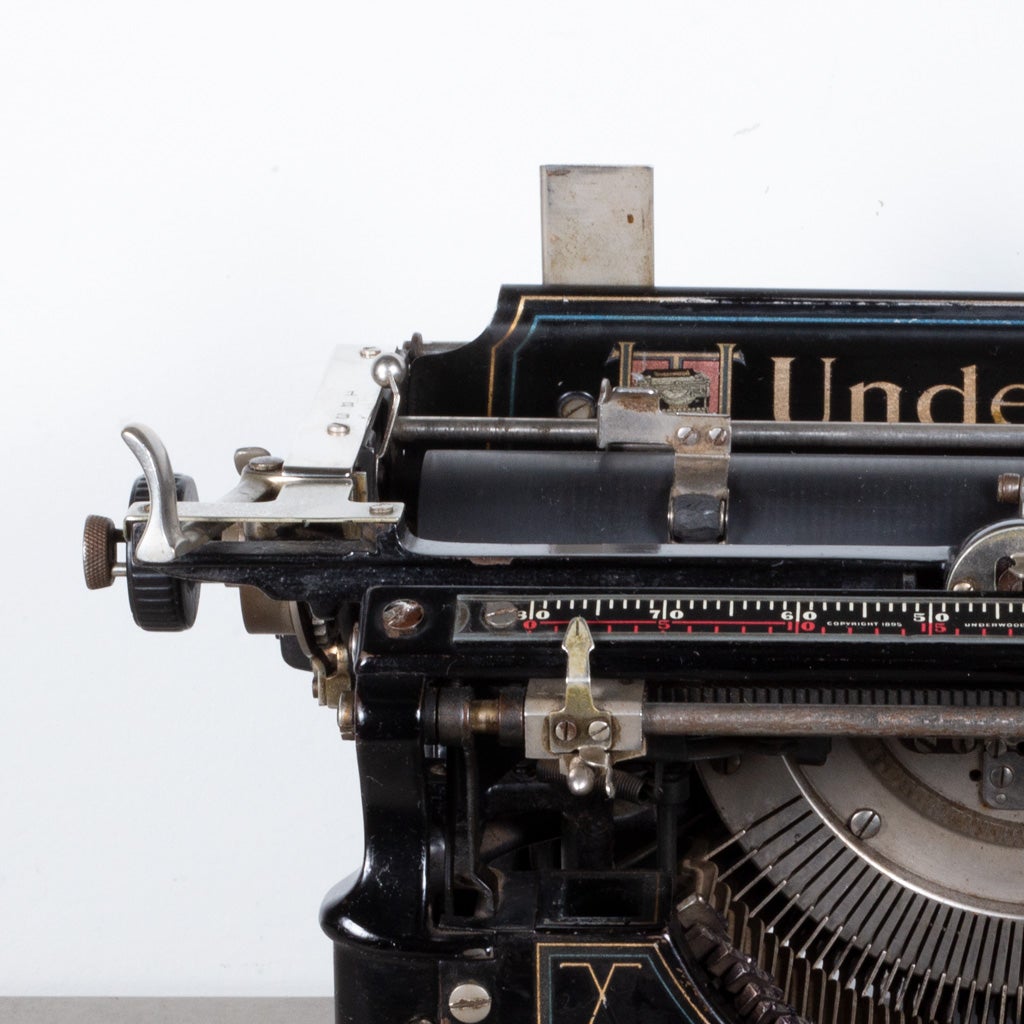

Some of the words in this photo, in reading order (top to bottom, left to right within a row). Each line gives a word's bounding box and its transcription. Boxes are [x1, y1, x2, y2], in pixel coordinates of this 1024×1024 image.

[649, 609, 684, 620] 70
[781, 610, 818, 621] 60
[913, 612, 950, 622] 50
